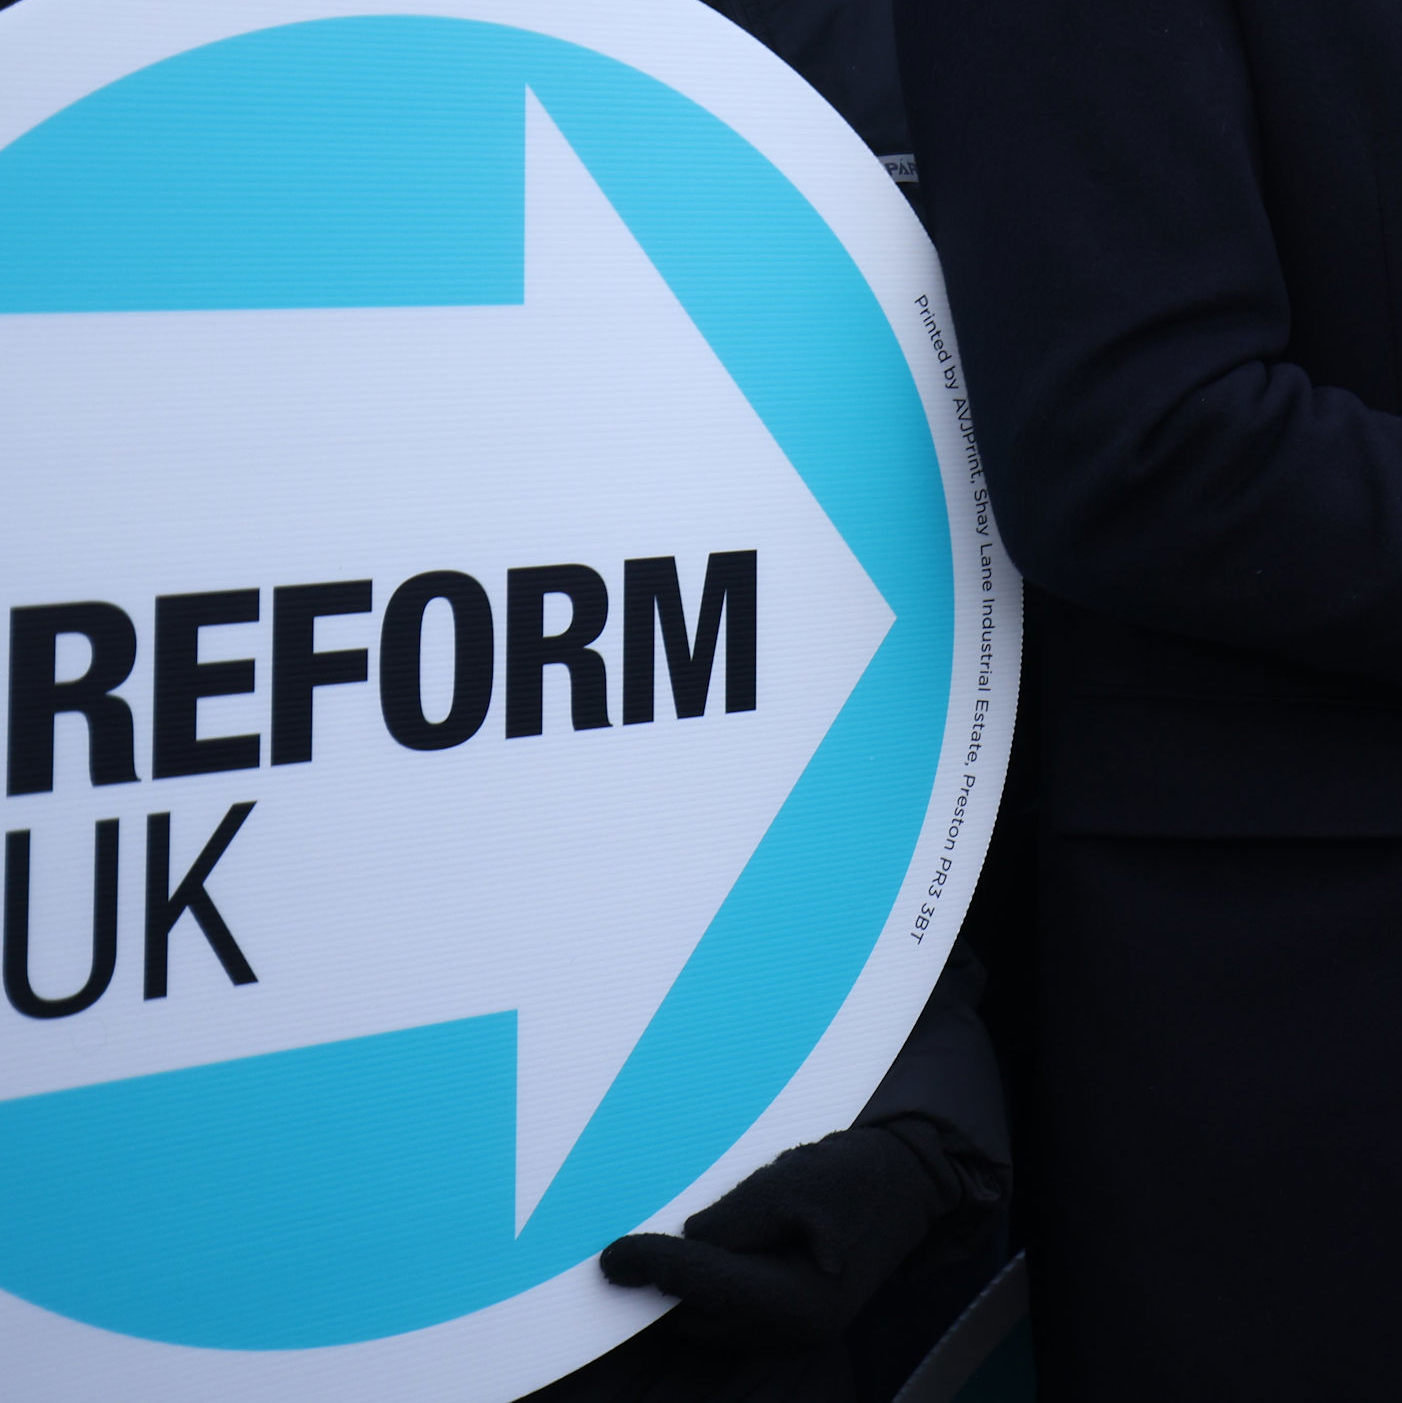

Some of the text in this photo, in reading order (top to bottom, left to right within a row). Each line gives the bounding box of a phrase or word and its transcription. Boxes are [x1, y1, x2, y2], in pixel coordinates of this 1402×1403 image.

[6, 549, 758, 797] REFORM
[909, 293, 996, 946] Printed by AVJPrint, Shay Lane Industrial Estate, Preston PR3 3BT
[2, 801, 258, 1021] UK
